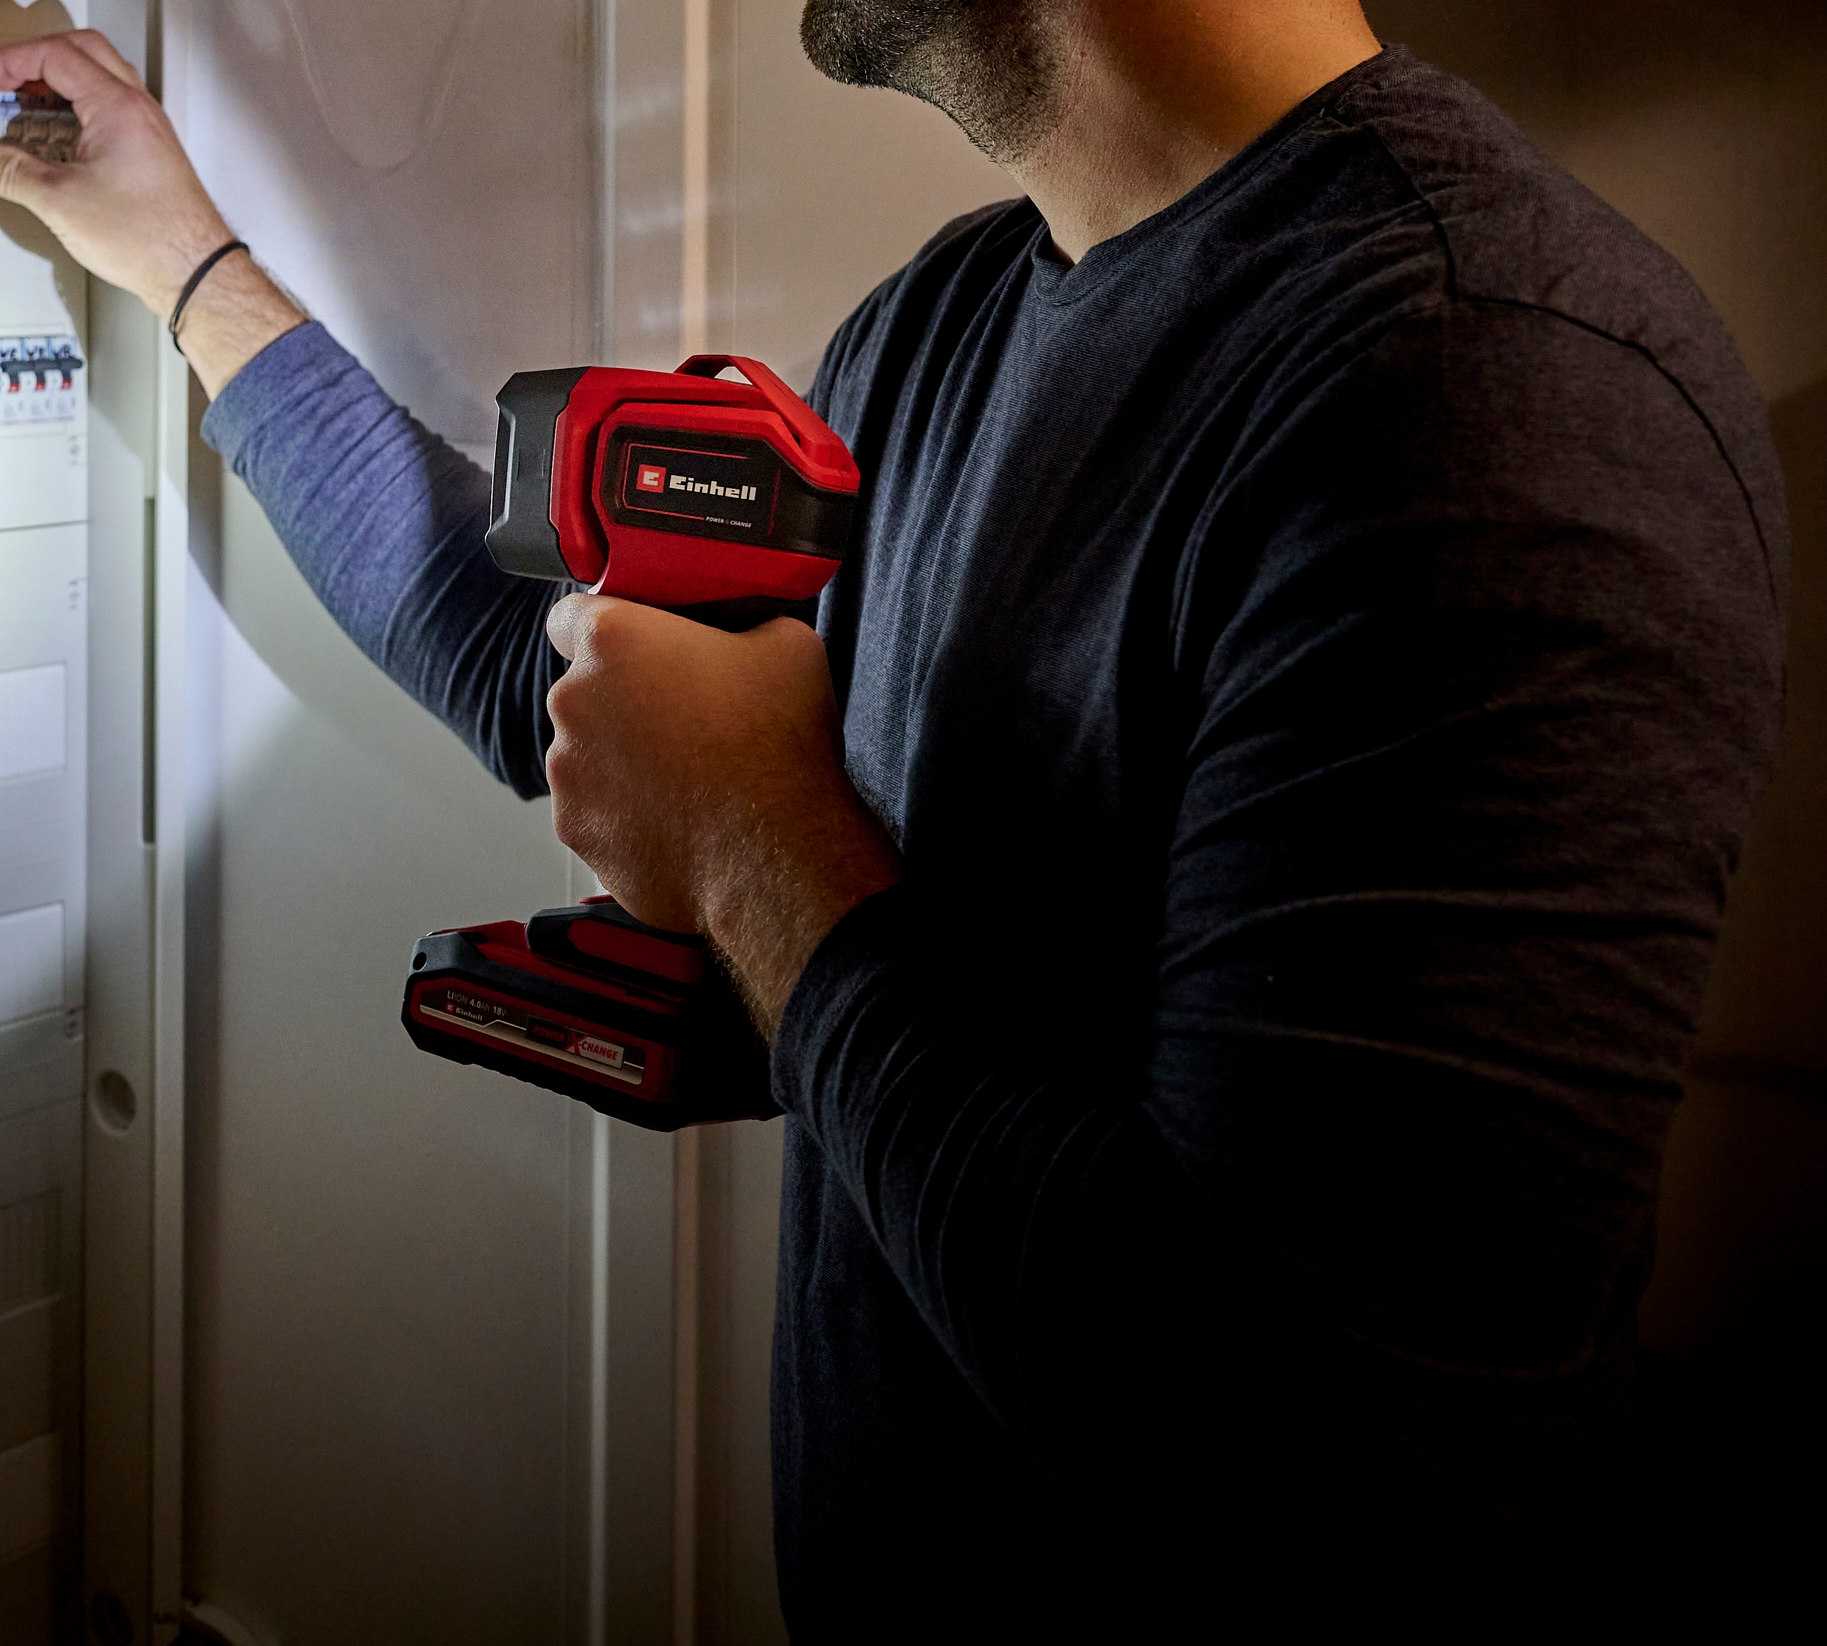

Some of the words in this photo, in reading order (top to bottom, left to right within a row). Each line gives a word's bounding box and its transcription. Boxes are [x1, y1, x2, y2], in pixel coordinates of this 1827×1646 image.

[669, 474, 757, 501] Einhell
[706, 516, 724, 524] POWER
[456, 1006, 483, 1021] Einhell
[493, 1005, 507, 1017] 18V
